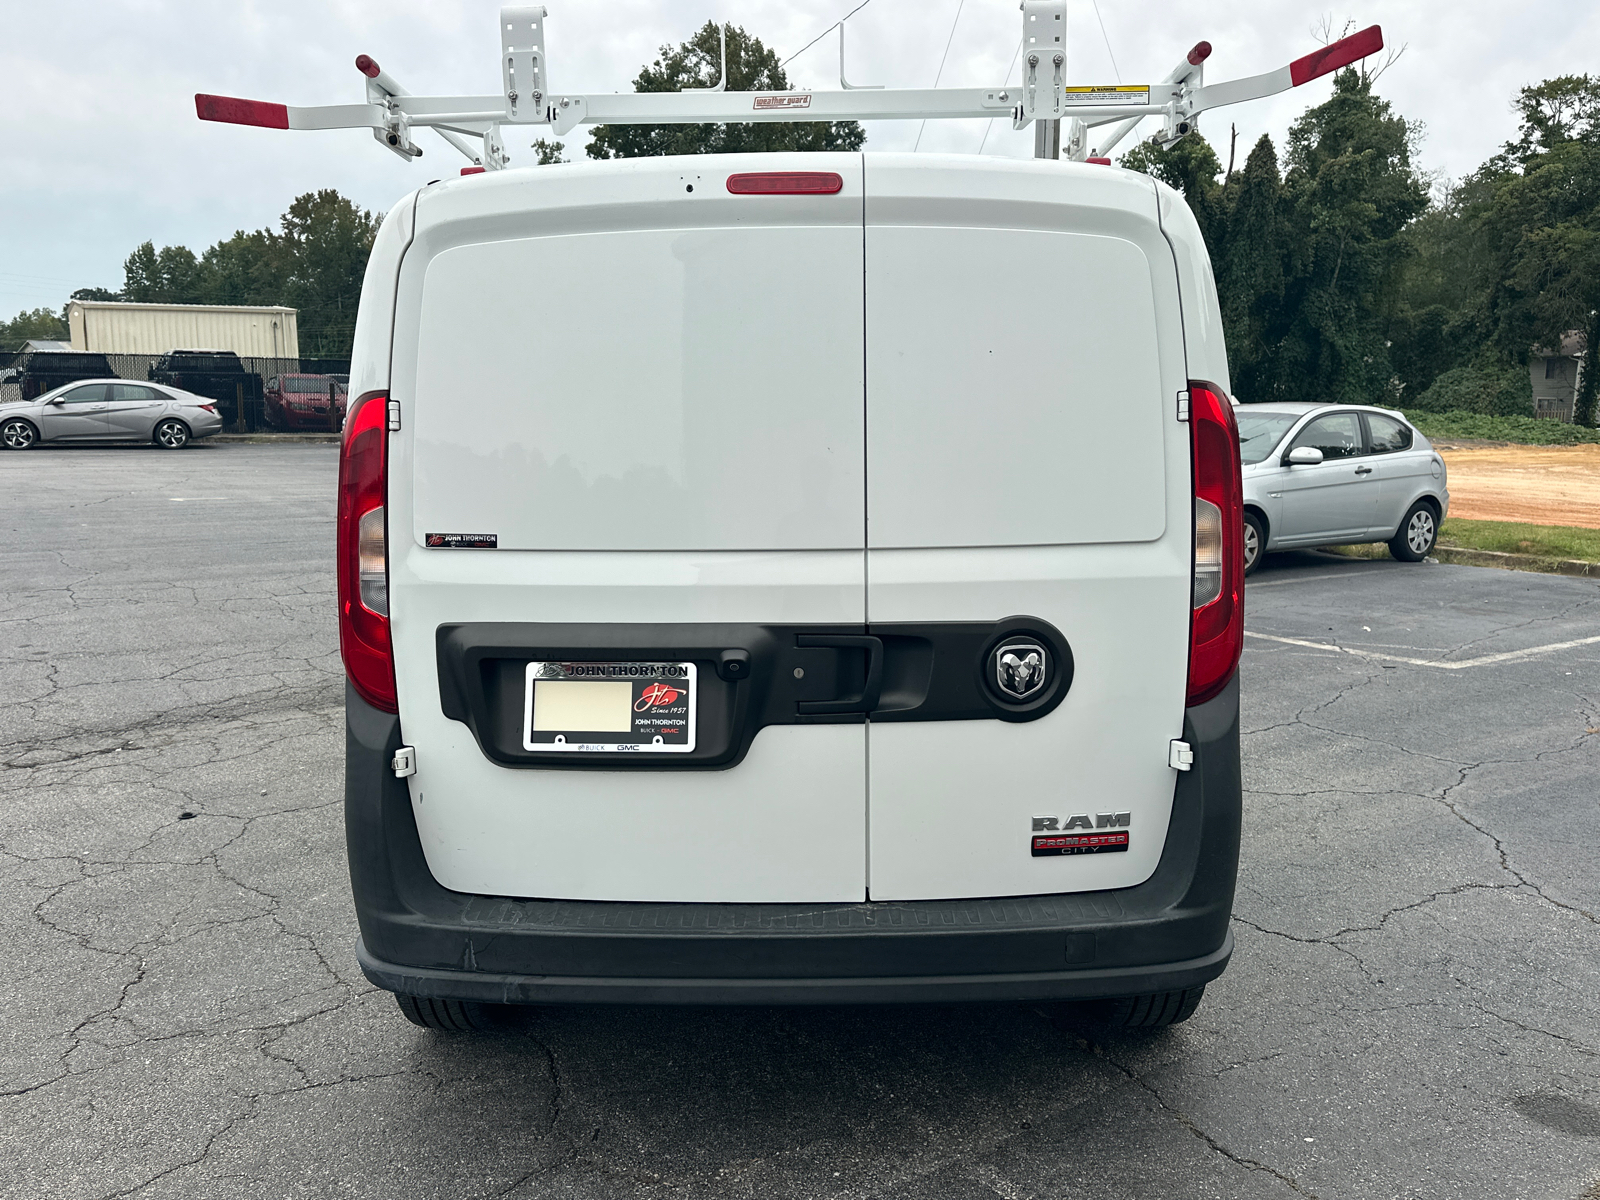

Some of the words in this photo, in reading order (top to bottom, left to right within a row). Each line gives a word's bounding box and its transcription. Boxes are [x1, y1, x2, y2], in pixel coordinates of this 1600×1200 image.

[756, 97, 786, 105] weather
[787, 95, 808, 104] guard
[568, 665, 606, 677] JOHN
[612, 665, 689, 677] THORNTON
[650, 706, 669, 714] Since
[669, 706, 687, 714] 1957
[634, 718, 651, 726] JOHN
[651, 718, 686, 726] THORNTON
[1032, 811, 1131, 831] RAM
[1061, 846, 1100, 855] CITY
